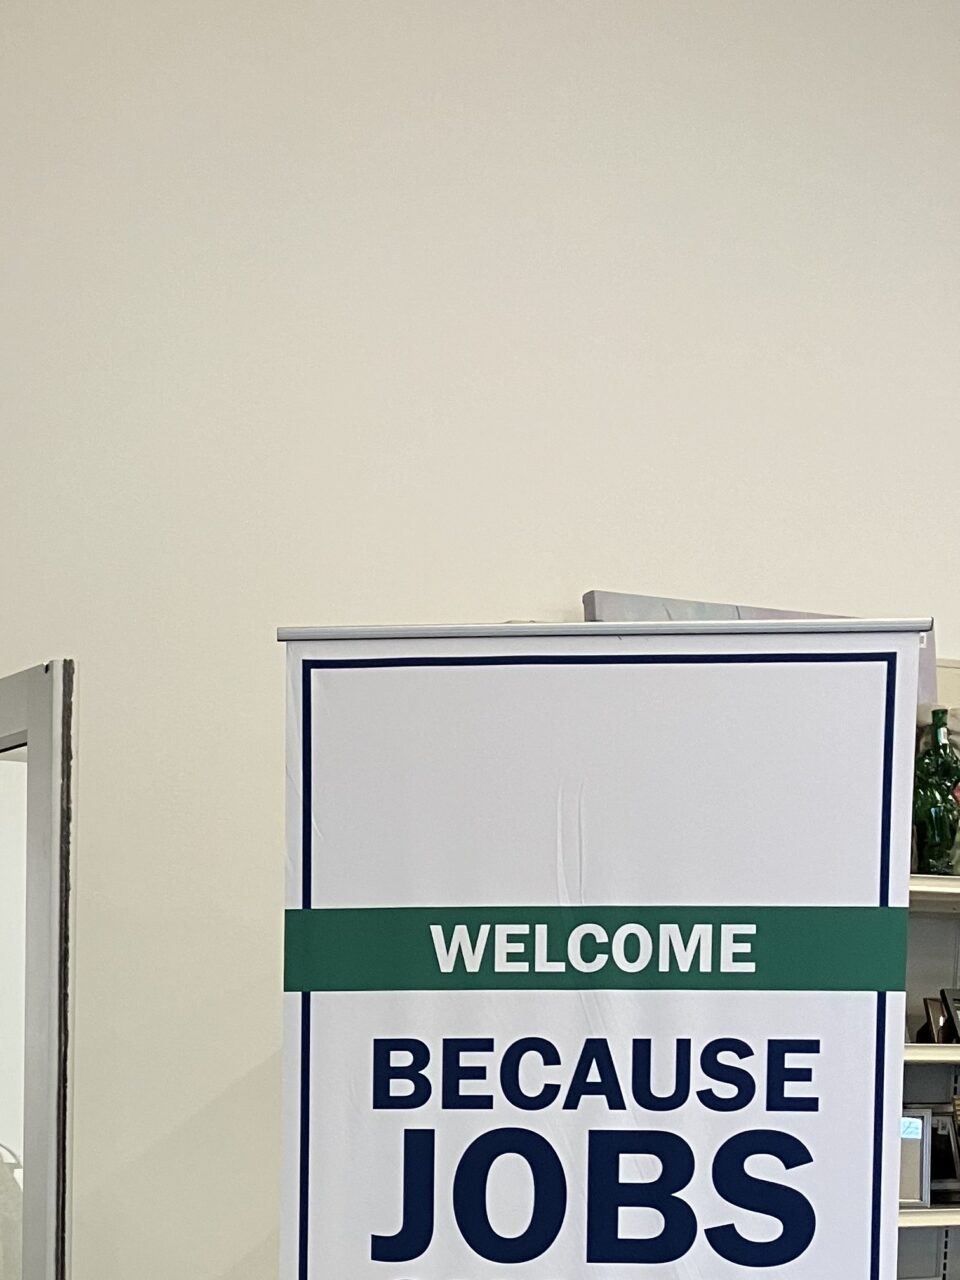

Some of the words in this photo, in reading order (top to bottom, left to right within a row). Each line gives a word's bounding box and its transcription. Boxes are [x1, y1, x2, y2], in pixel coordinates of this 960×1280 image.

[429, 923, 758, 974] WELCOME
[372, 1036, 821, 1113] BECAUSE
[370, 1127, 817, 1268] JOBS
